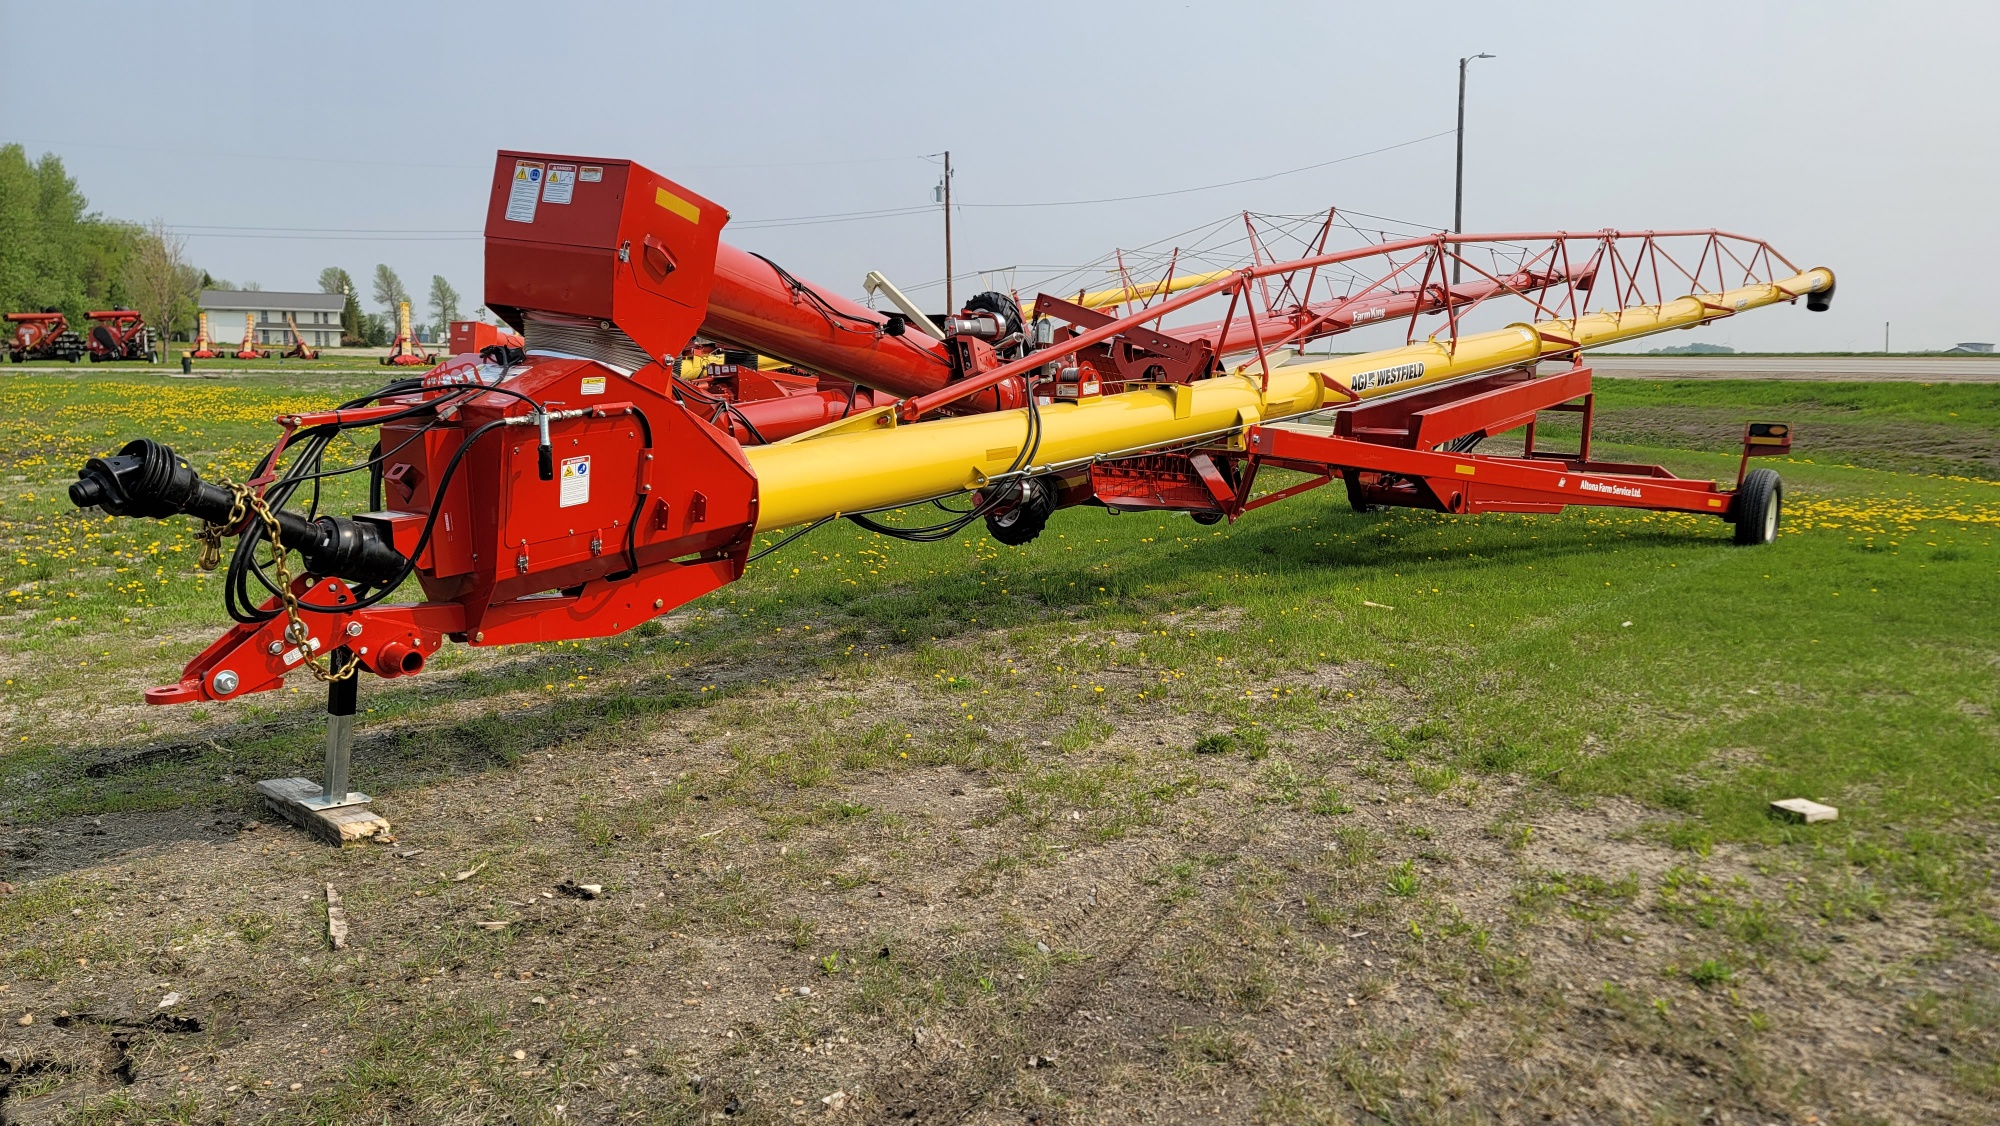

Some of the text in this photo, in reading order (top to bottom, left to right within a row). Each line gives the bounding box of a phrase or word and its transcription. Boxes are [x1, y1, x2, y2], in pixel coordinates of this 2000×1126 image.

[1351, 363, 1424, 391] AGI WESTFIELD
[1580, 480, 1641, 497] Altona Farm Service Ltd.
